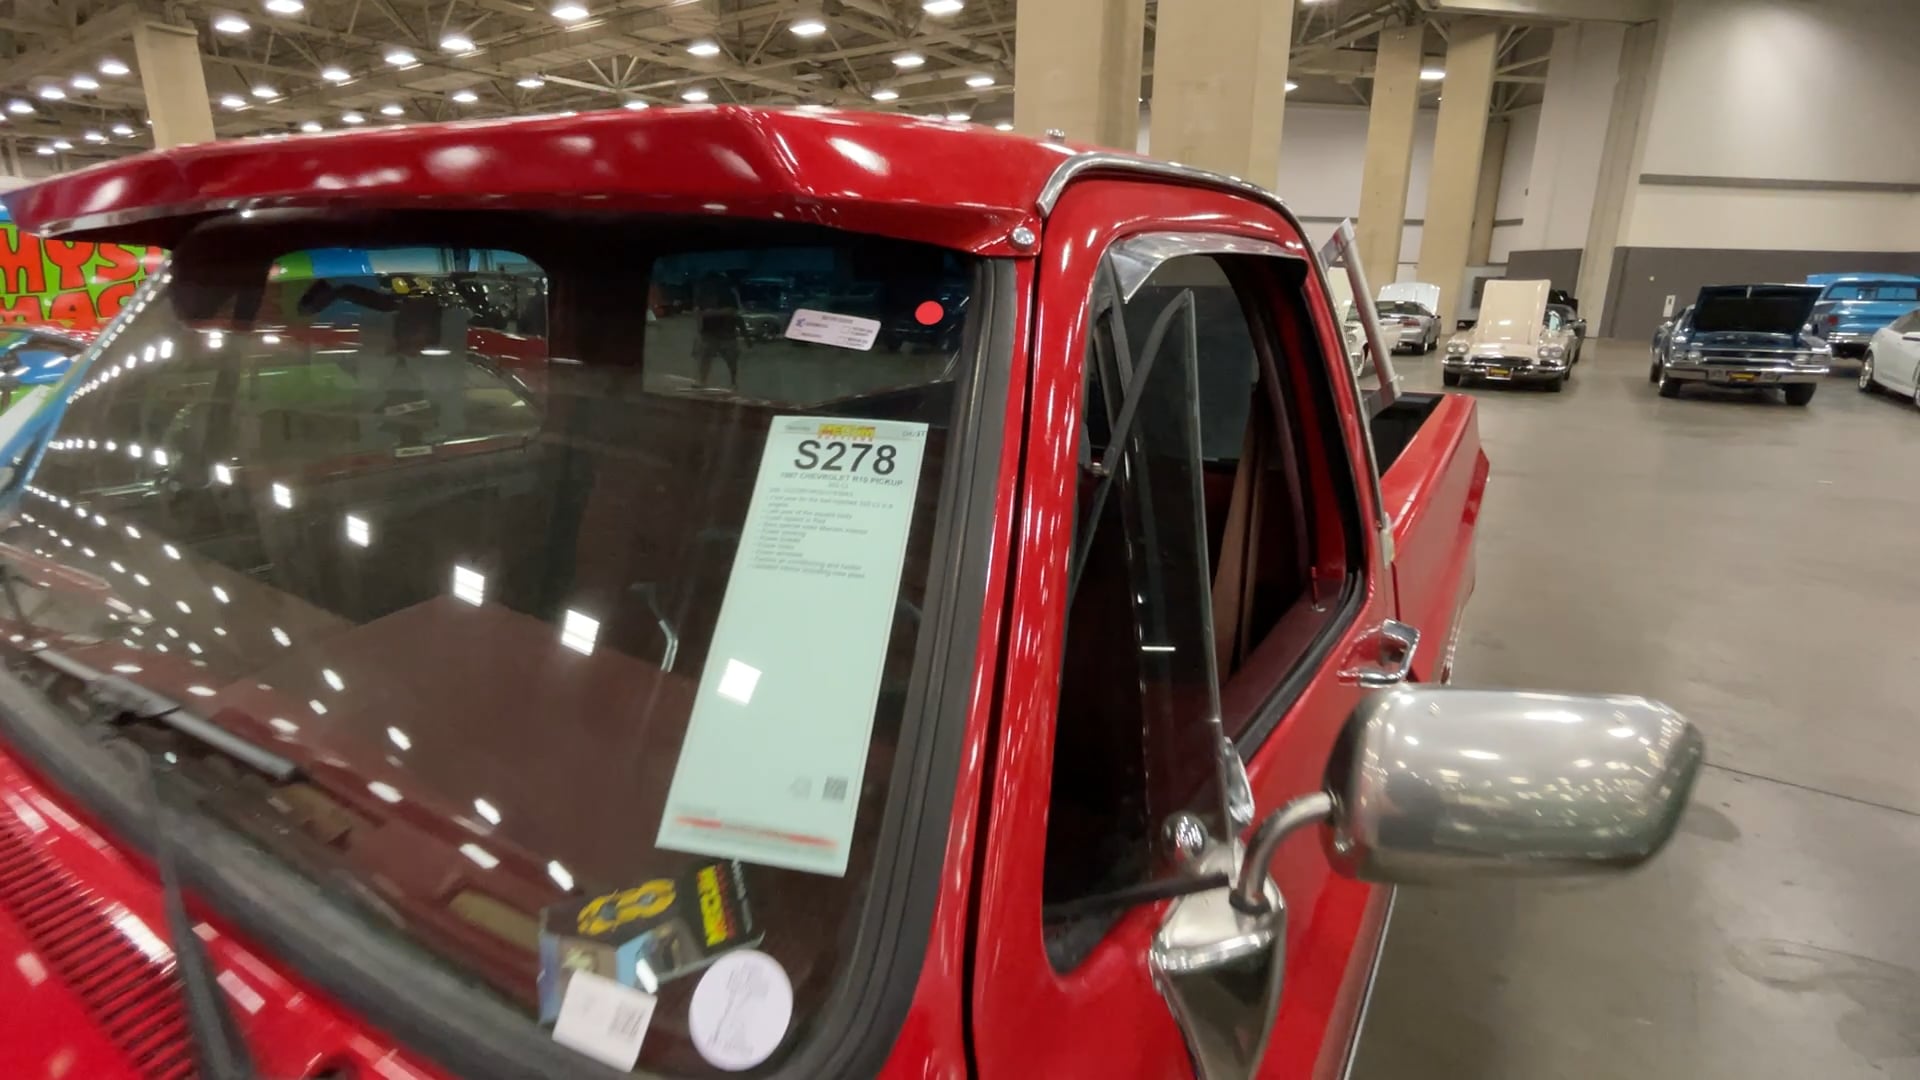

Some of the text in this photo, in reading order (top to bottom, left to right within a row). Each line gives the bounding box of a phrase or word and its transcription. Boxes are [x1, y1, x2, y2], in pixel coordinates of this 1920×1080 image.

[0, 281, 138, 331] MAC
[794, 440, 897, 475] S278
[869, 477, 904, 487] PICKUP
